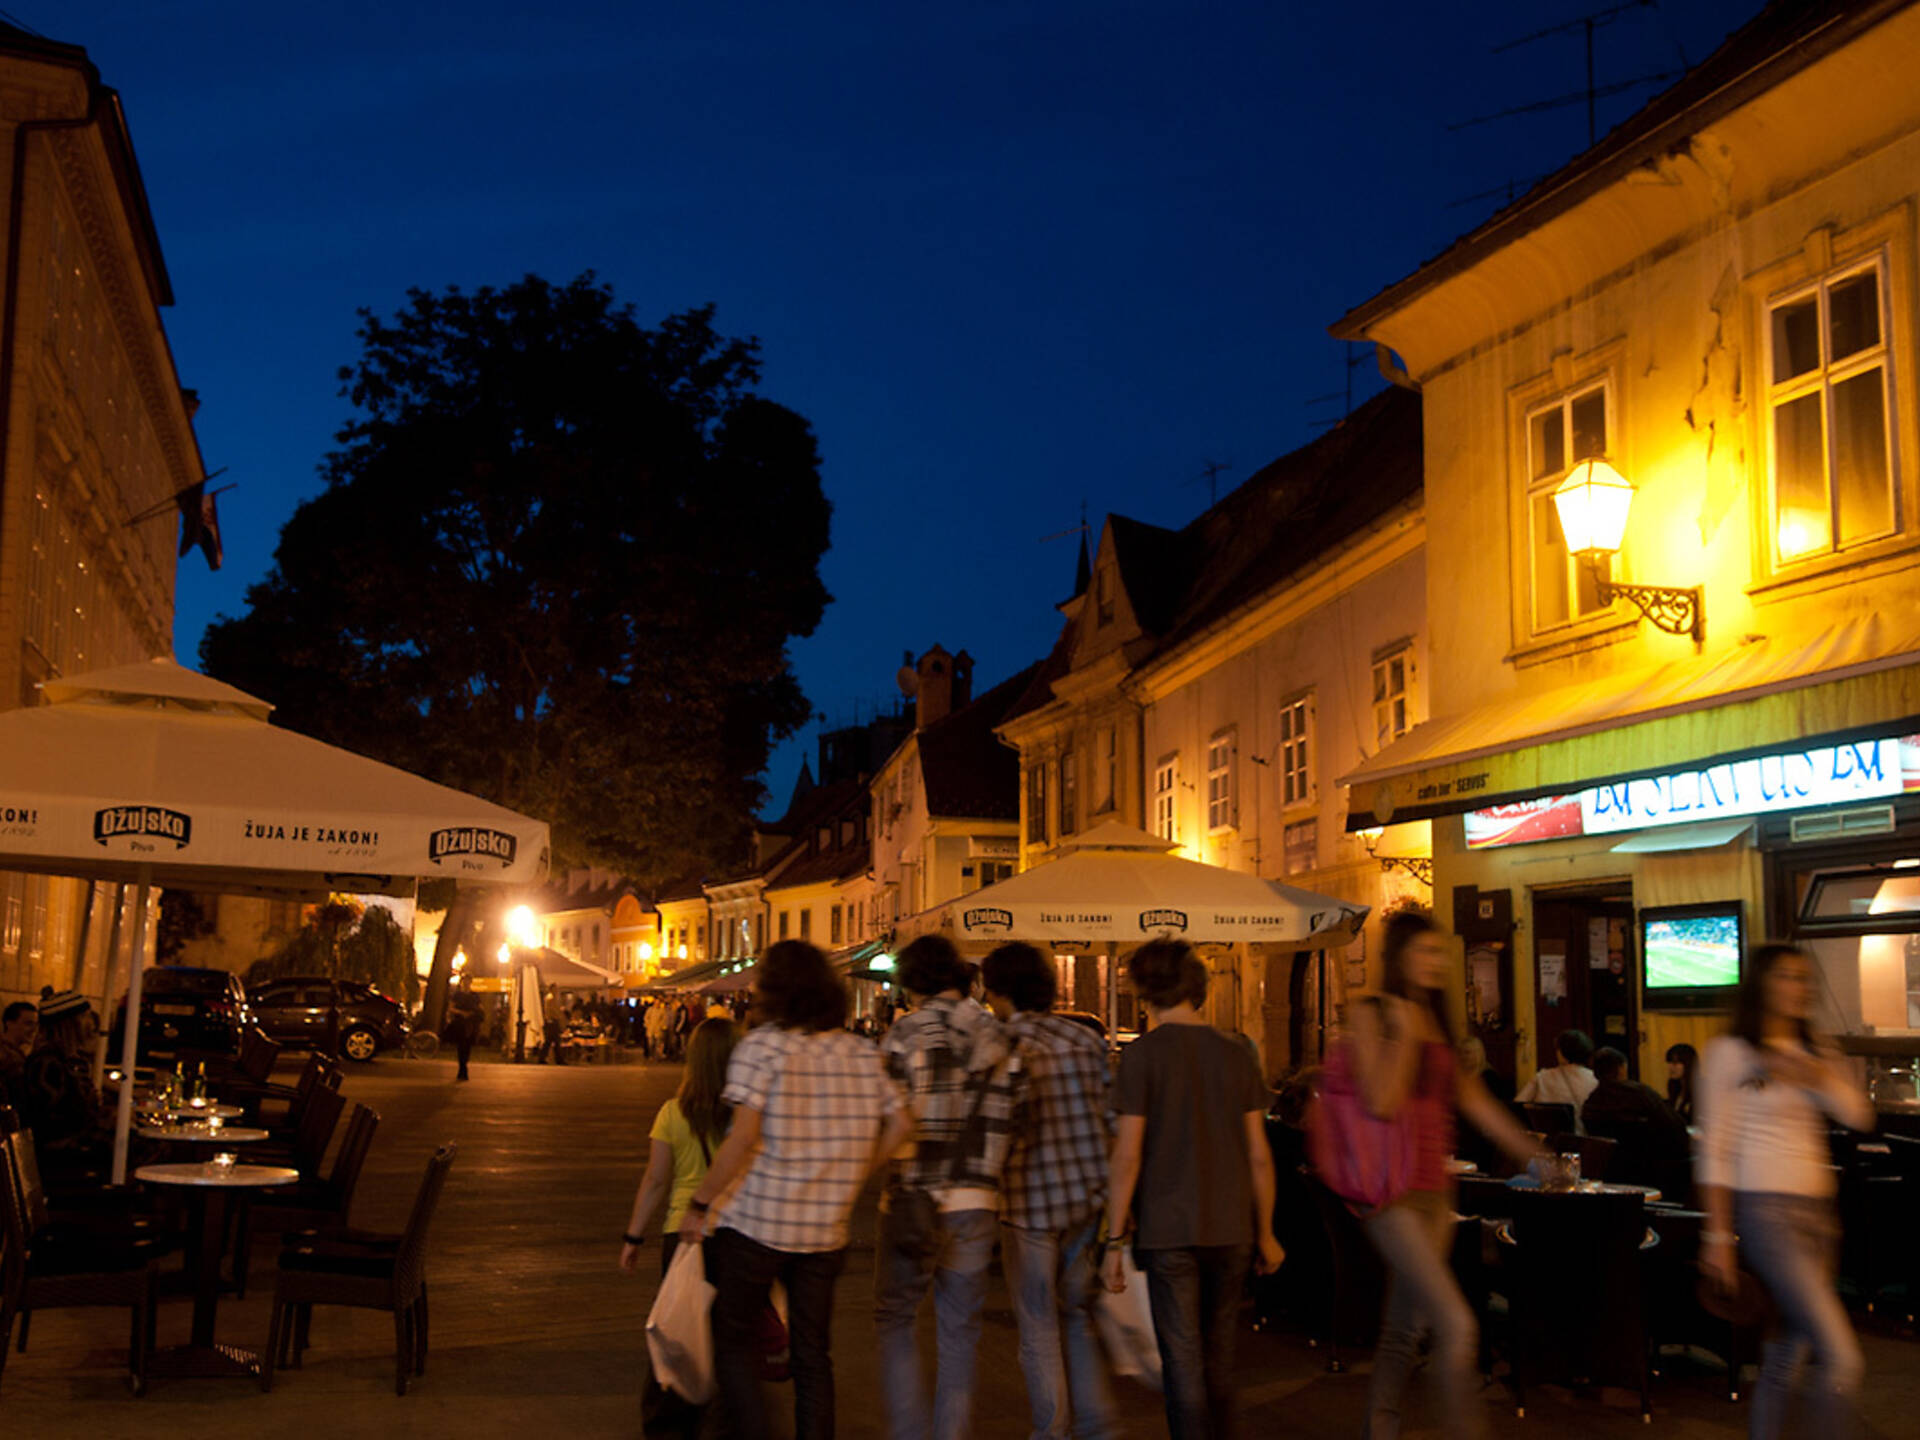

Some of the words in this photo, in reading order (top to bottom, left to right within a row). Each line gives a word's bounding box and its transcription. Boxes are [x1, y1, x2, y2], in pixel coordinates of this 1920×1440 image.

[101, 807, 184, 837] Ožujsko
[245, 820, 285, 839] ŽUJA
[292, 827, 308, 840] JE
[317, 829, 379, 845] ZAKON!
[131, 841, 155, 852] Pivo
[436, 829, 510, 856] Ožujsko
[462, 860, 484, 870] Pivo
